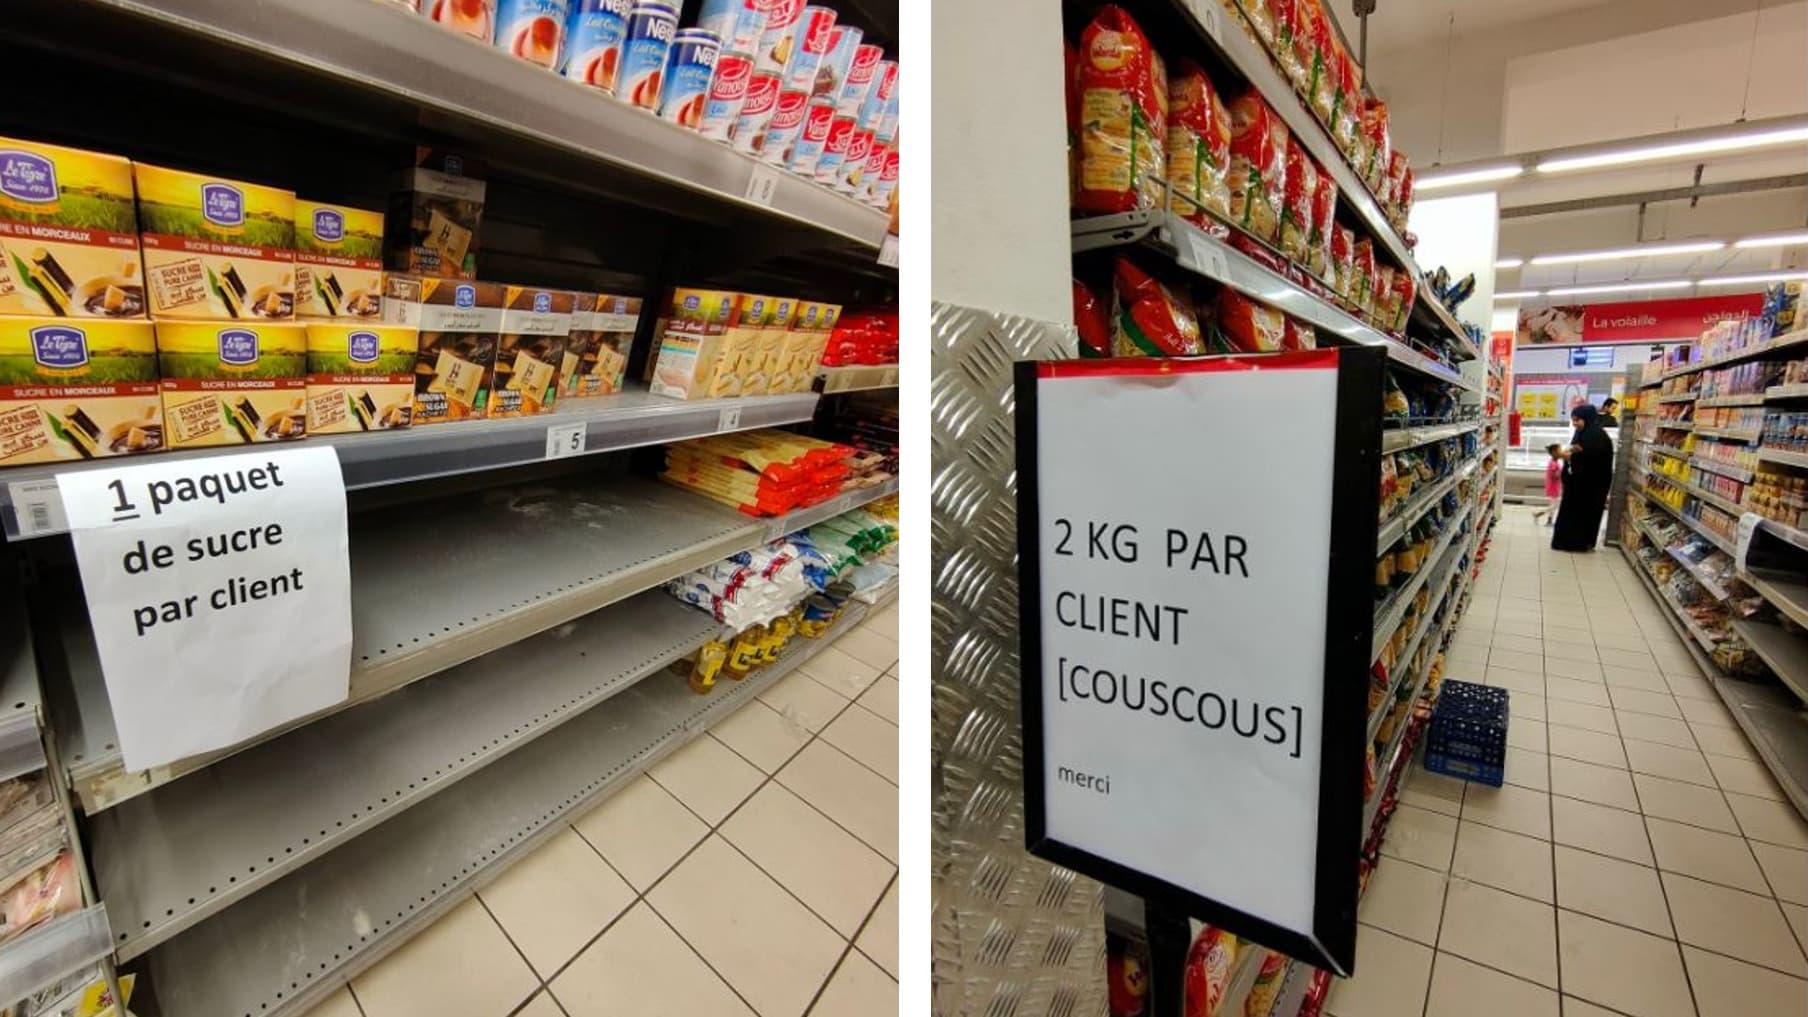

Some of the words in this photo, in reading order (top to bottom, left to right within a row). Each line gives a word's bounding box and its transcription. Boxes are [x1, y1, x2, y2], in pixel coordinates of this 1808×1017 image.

[31, 225, 91, 243] MORCEAUX
[1593, 317, 1608, 329] La
[1610, 314, 1657, 328] volaille
[64, 386, 117, 396] MORCEAUX
[571, 432, 580, 450] 5
[108, 478, 139, 519] 1
[148, 462, 284, 515] paquet
[123, 540, 175, 575] de
[187, 522, 283, 563] sucre
[1054, 518, 1074, 556] 2
[1088, 521, 1138, 563] KG
[1166, 528, 1249, 578] PAR
[133, 593, 200, 636] par
[209, 567, 304, 612] client
[1056, 590, 1188, 645] CLIENT
[1059, 657, 1303, 759] [COUSCOUS]
[1058, 766, 1111, 795] merci
